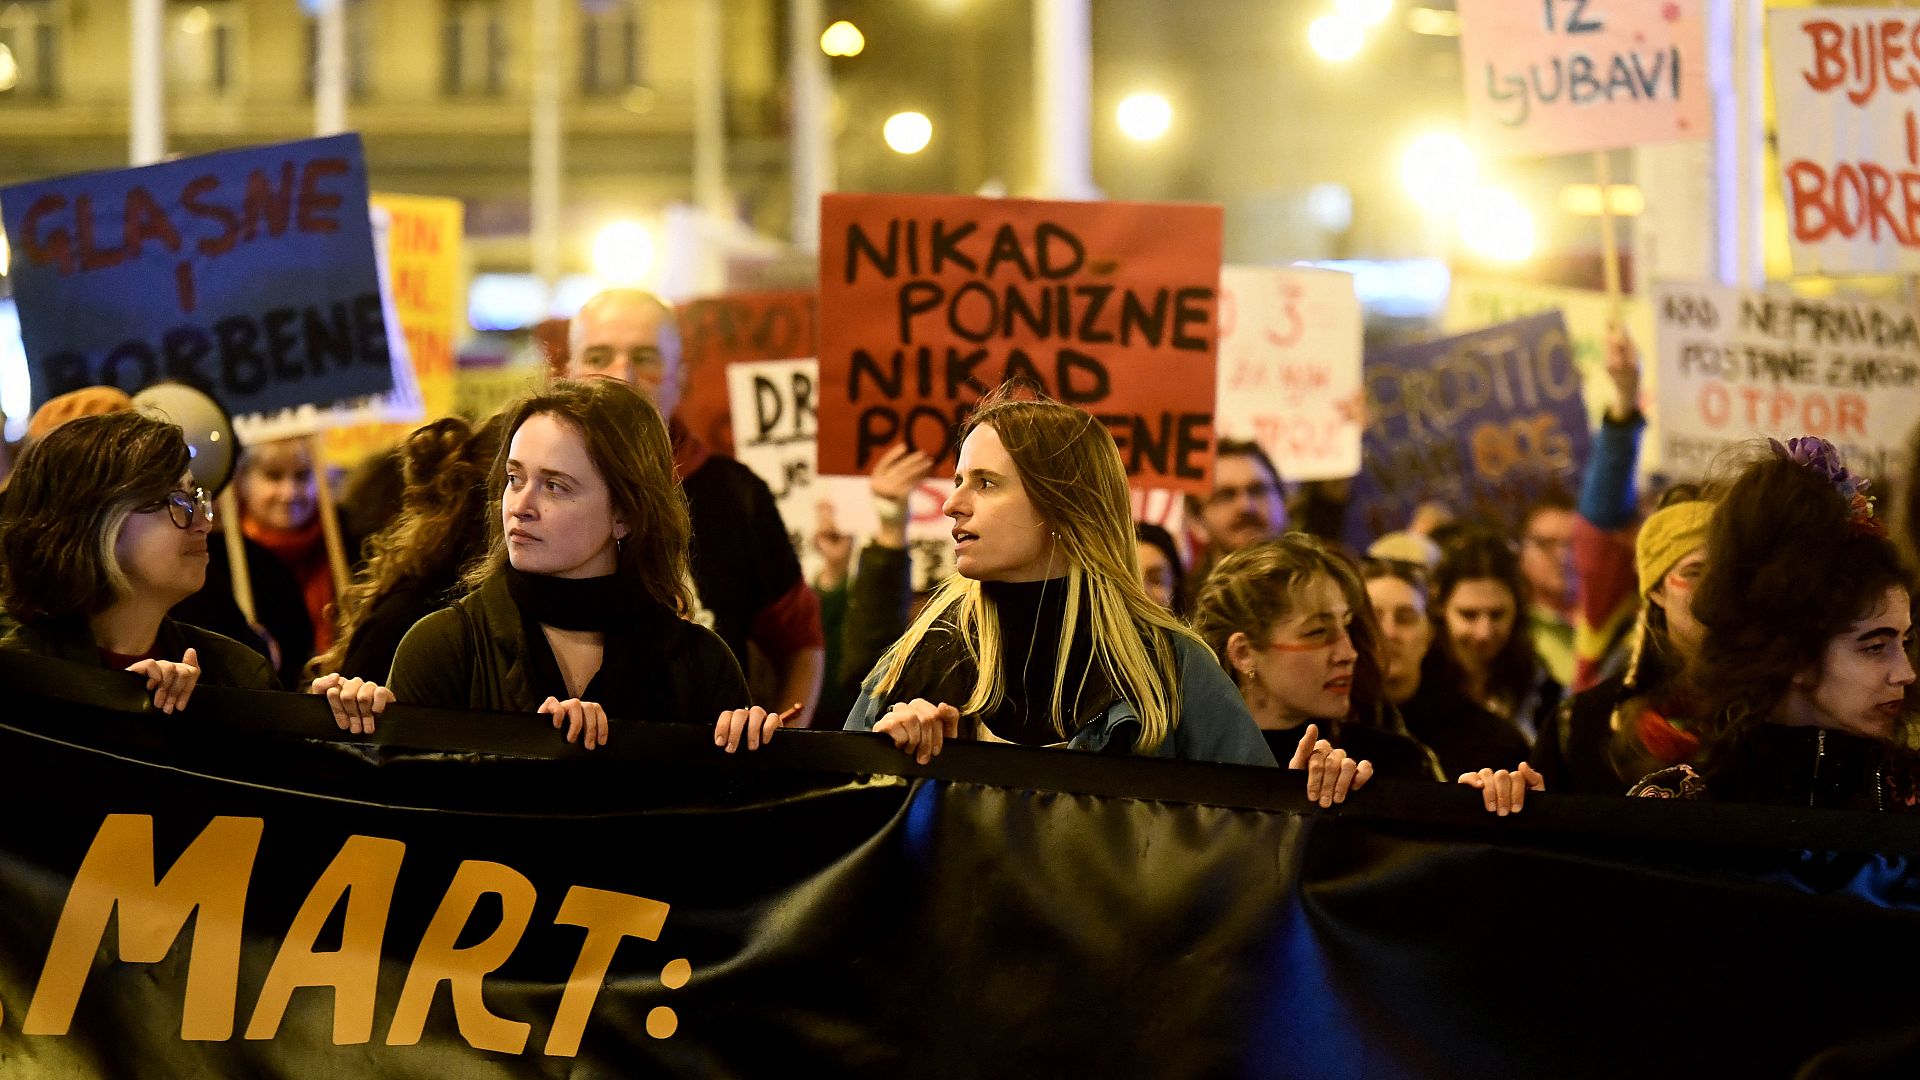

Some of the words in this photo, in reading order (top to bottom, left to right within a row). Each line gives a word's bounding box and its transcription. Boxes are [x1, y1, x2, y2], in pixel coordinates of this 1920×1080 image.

[20, 158, 349, 275] GLASNE
[845, 217, 1086, 284] NIKAD
[175, 261, 196, 313] I
[43, 295, 391, 397] BORBENE
[848, 346, 1111, 403] NIKAD
[857, 405, 1213, 479] POENE
[1698, 380, 1868, 439] OTPOR
